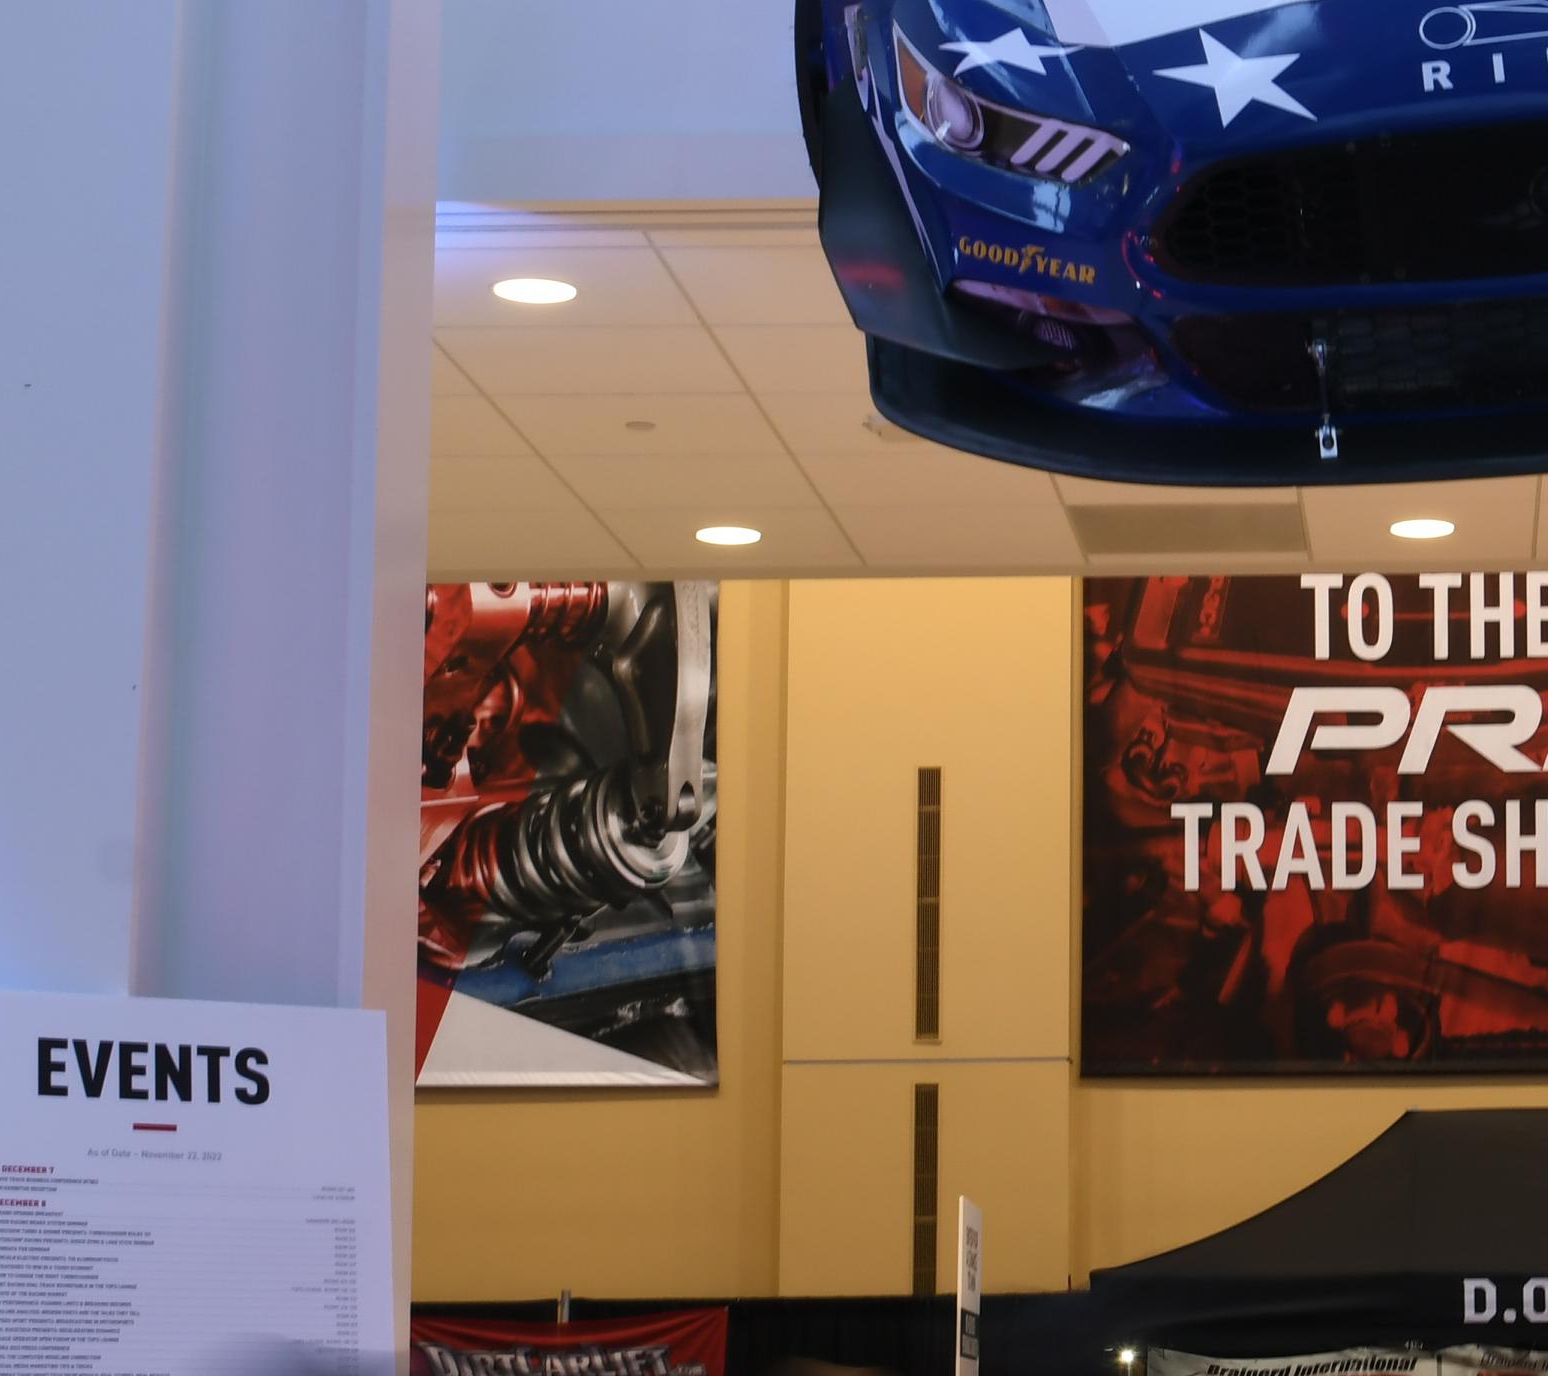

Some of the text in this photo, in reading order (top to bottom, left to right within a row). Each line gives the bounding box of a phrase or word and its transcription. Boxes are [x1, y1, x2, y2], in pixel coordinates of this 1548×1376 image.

[959, 235, 1097, 284] GOODYEAR
[1301, 571, 1395, 662] TO
[1170, 800, 1426, 892] TRADE
[37, 1035, 271, 1107] EVENTS
[1, 1164, 48, 1174] DECEMBER
